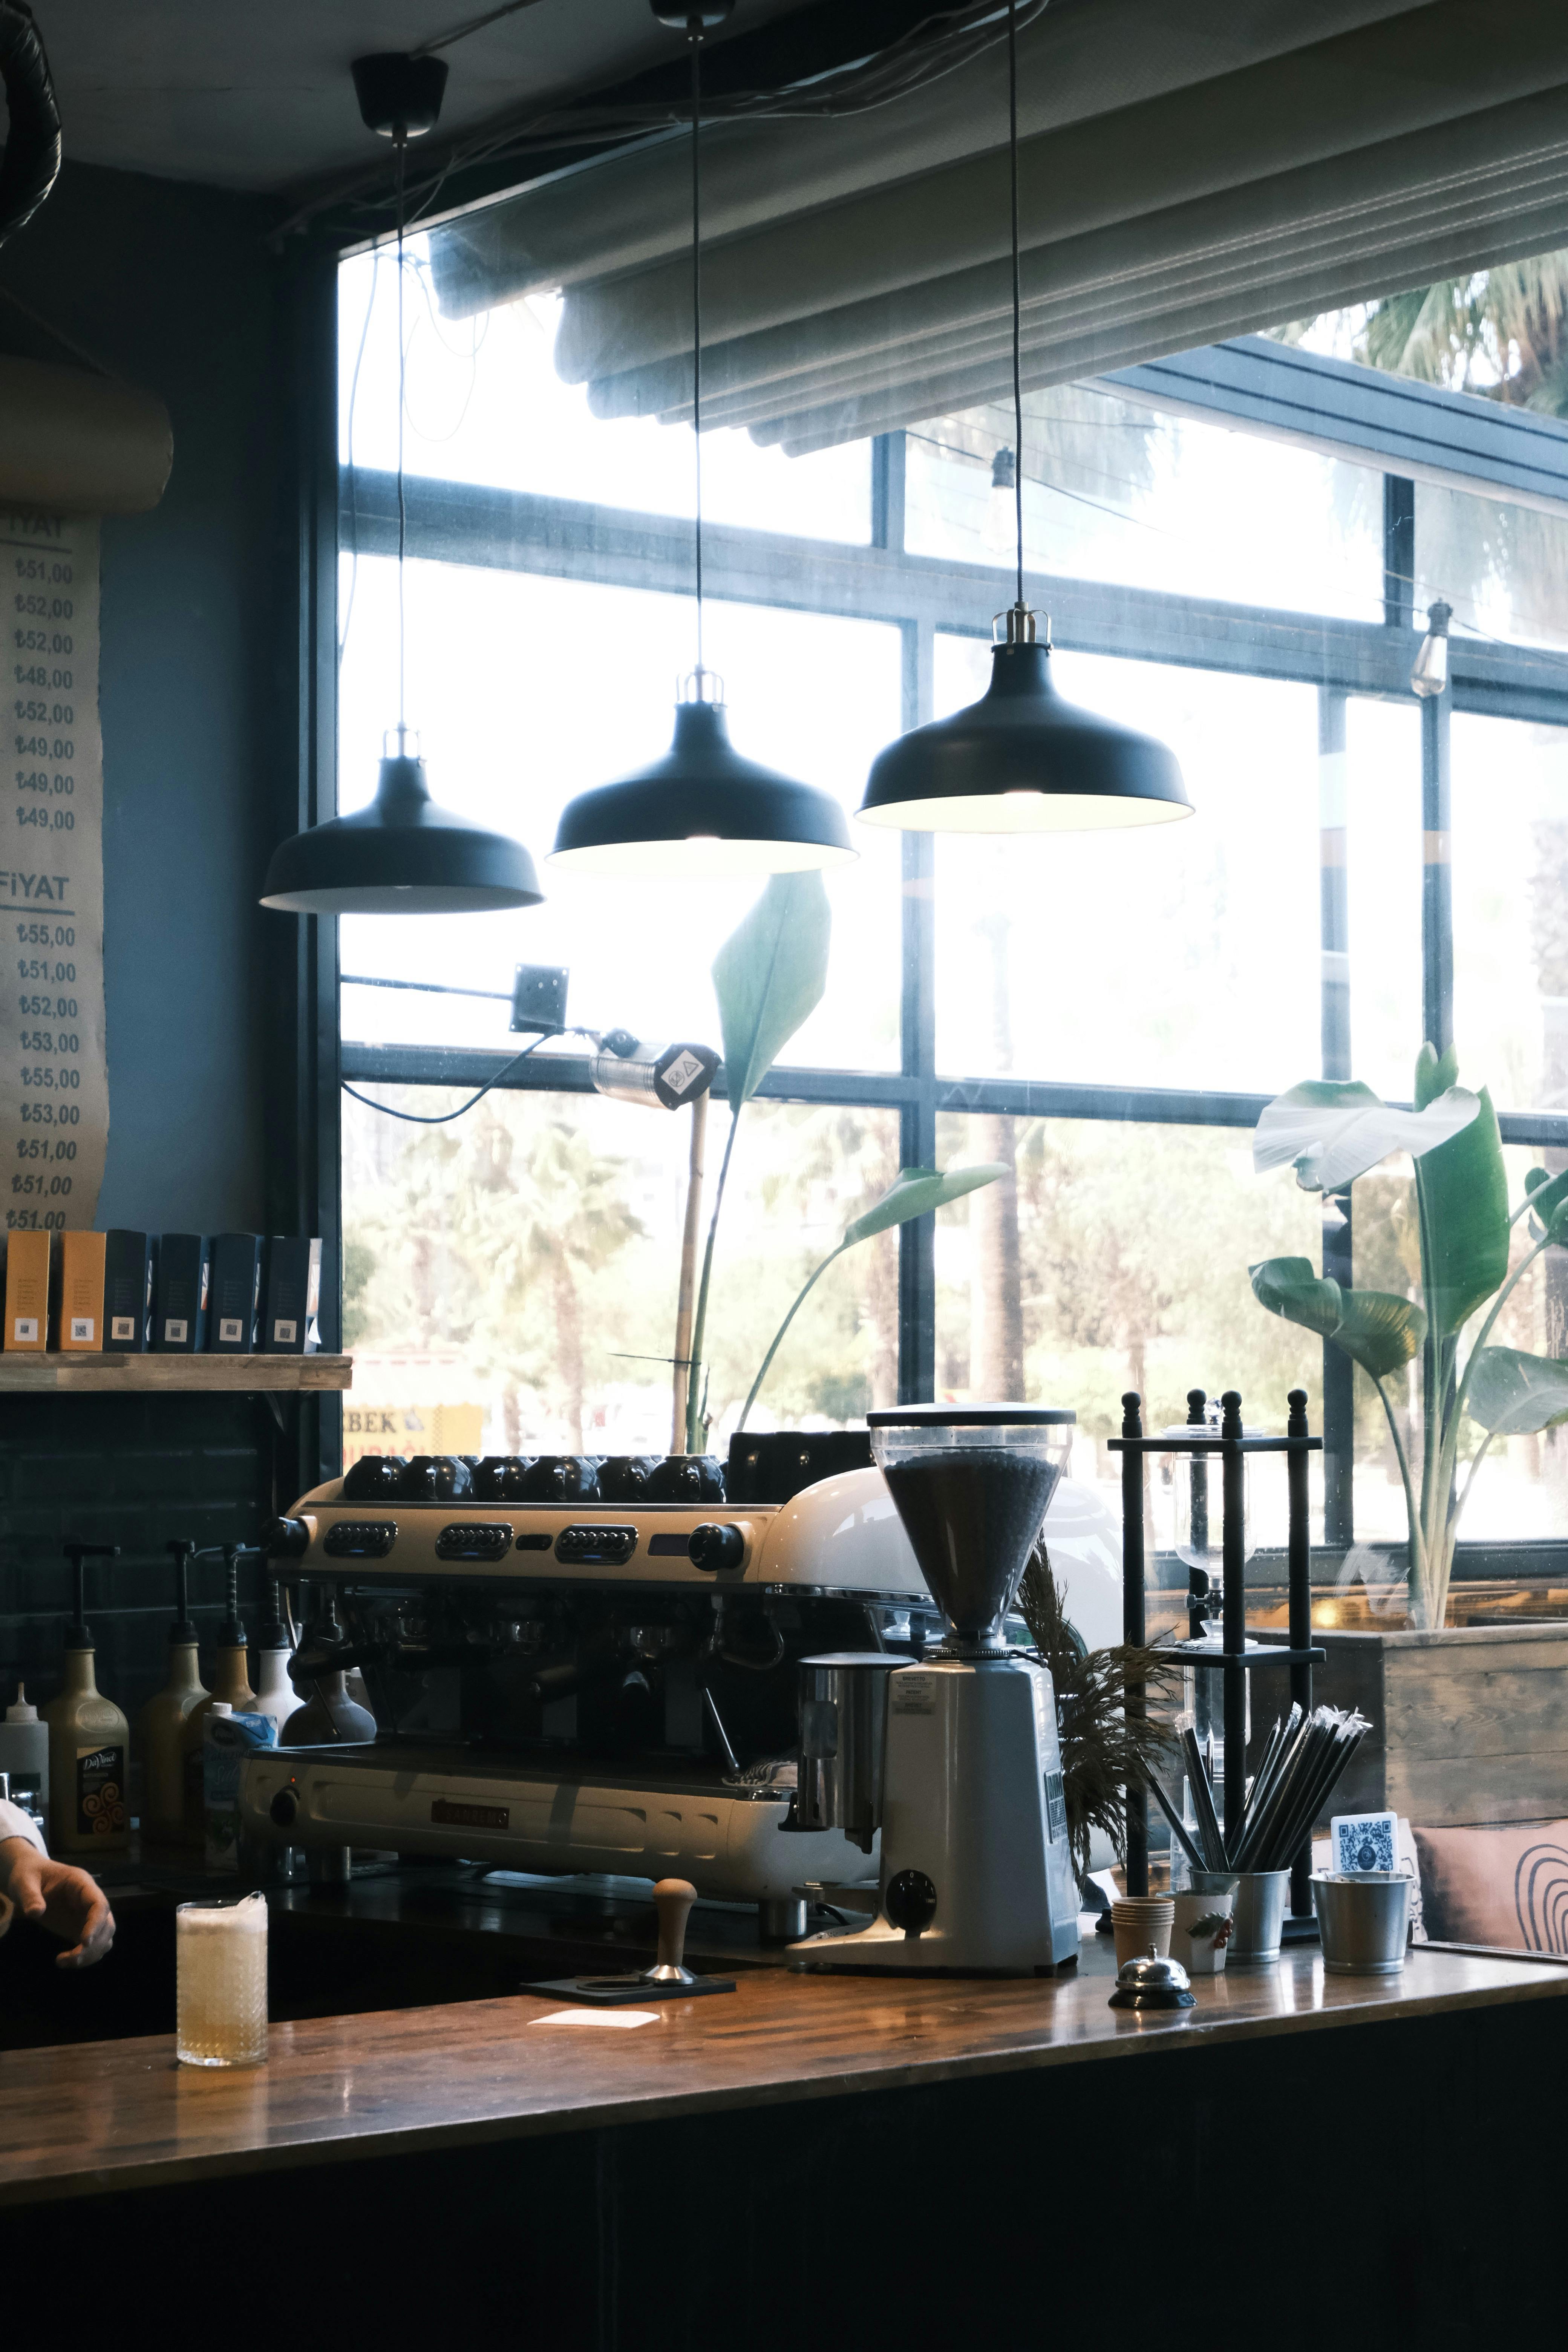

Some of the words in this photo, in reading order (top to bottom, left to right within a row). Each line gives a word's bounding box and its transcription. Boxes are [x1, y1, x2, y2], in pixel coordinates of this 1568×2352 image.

[15, 558, 73, 584] ₺51,00
[15, 593, 73, 619] ₺52,00
[14, 629, 73, 655] ₺52,00
[14, 665, 72, 689] ₺48,00
[14, 700, 74, 725] ₺52,00
[15, 735, 74, 760] ₺49,00
[16, 771, 74, 796] ₺49,00
[16, 806, 75, 831] ₺49,00
[17, 923, 75, 948] ₺55,00
[18, 959, 76, 983] ₺51,00
[19, 995, 78, 1019] ₺52,00
[20, 1031, 79, 1055] ₺53,00
[21, 1066, 80, 1090] ₺55,00
[20, 1102, 80, 1127] ₺53,00
[17, 1139, 77, 1162] ₺51,00
[11, 1174, 72, 1197] ₺51,00
[343, 1410, 396, 1433] BEK
